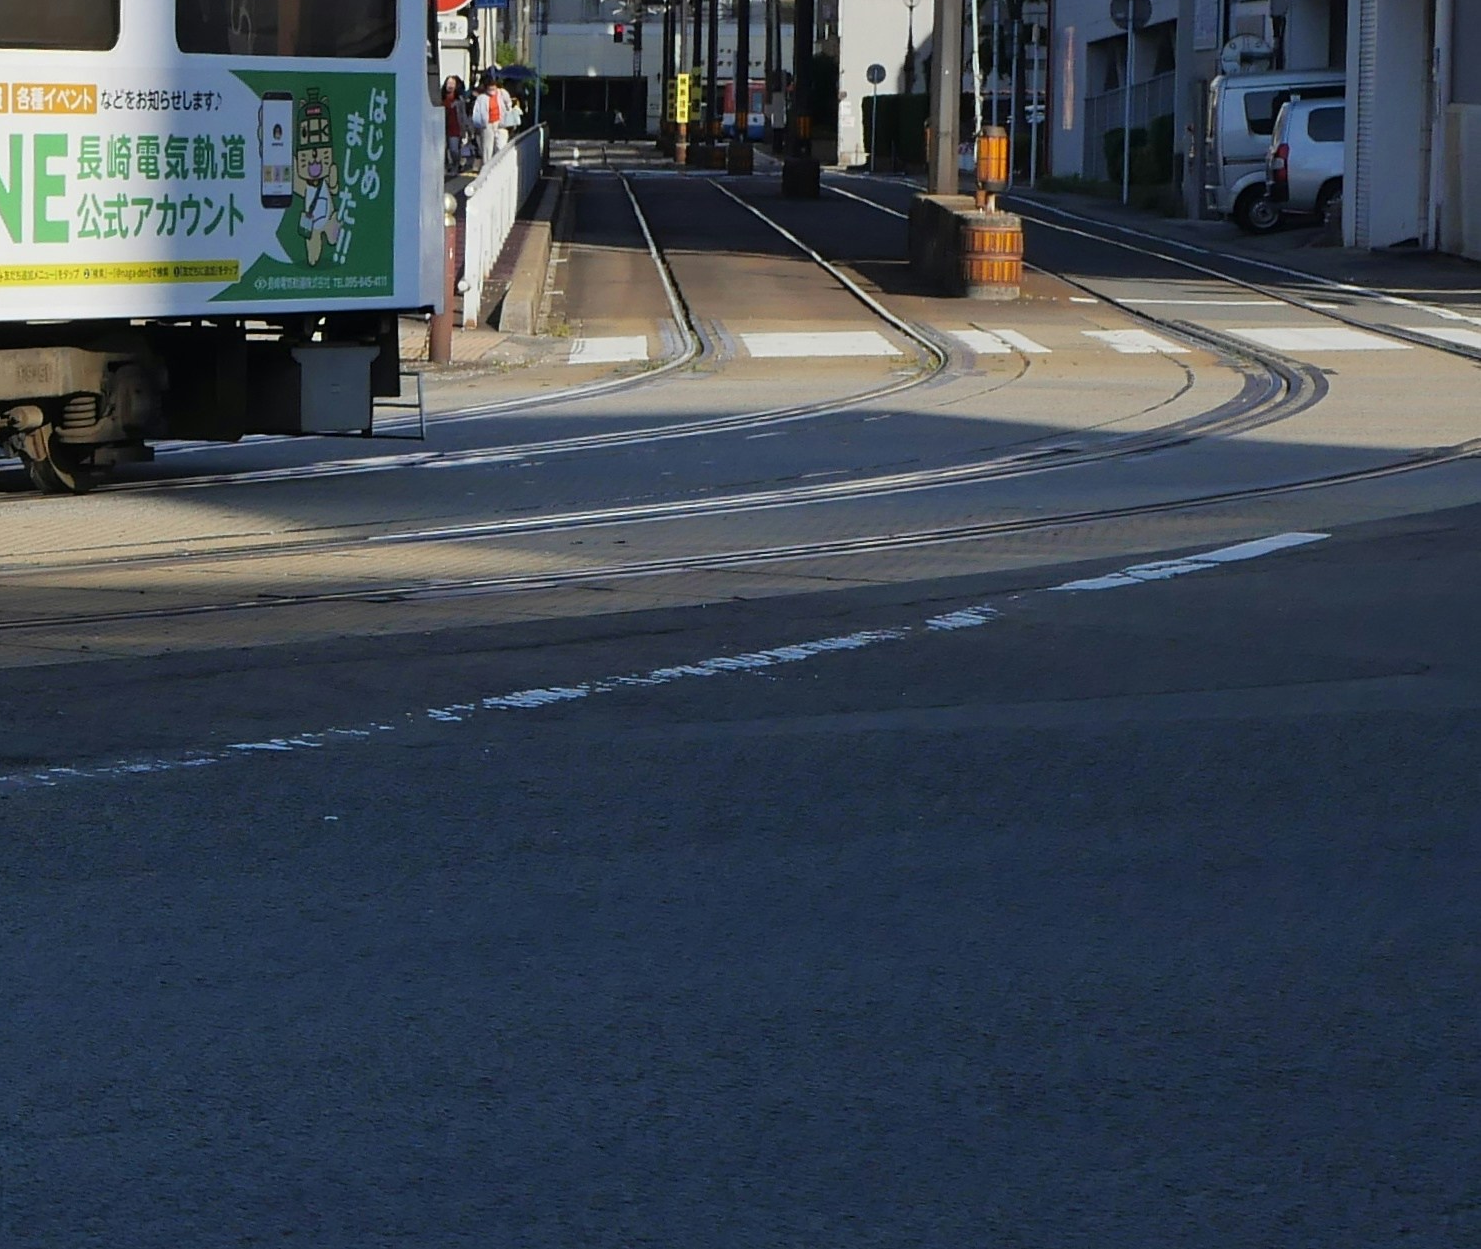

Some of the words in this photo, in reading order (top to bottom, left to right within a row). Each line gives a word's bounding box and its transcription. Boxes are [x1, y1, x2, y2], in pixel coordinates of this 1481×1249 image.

[16, 87, 93, 112] 各種イベント
[76, 133, 246, 181] 長崎電気軌道
[76, 192, 245, 240] 公式アカウント
